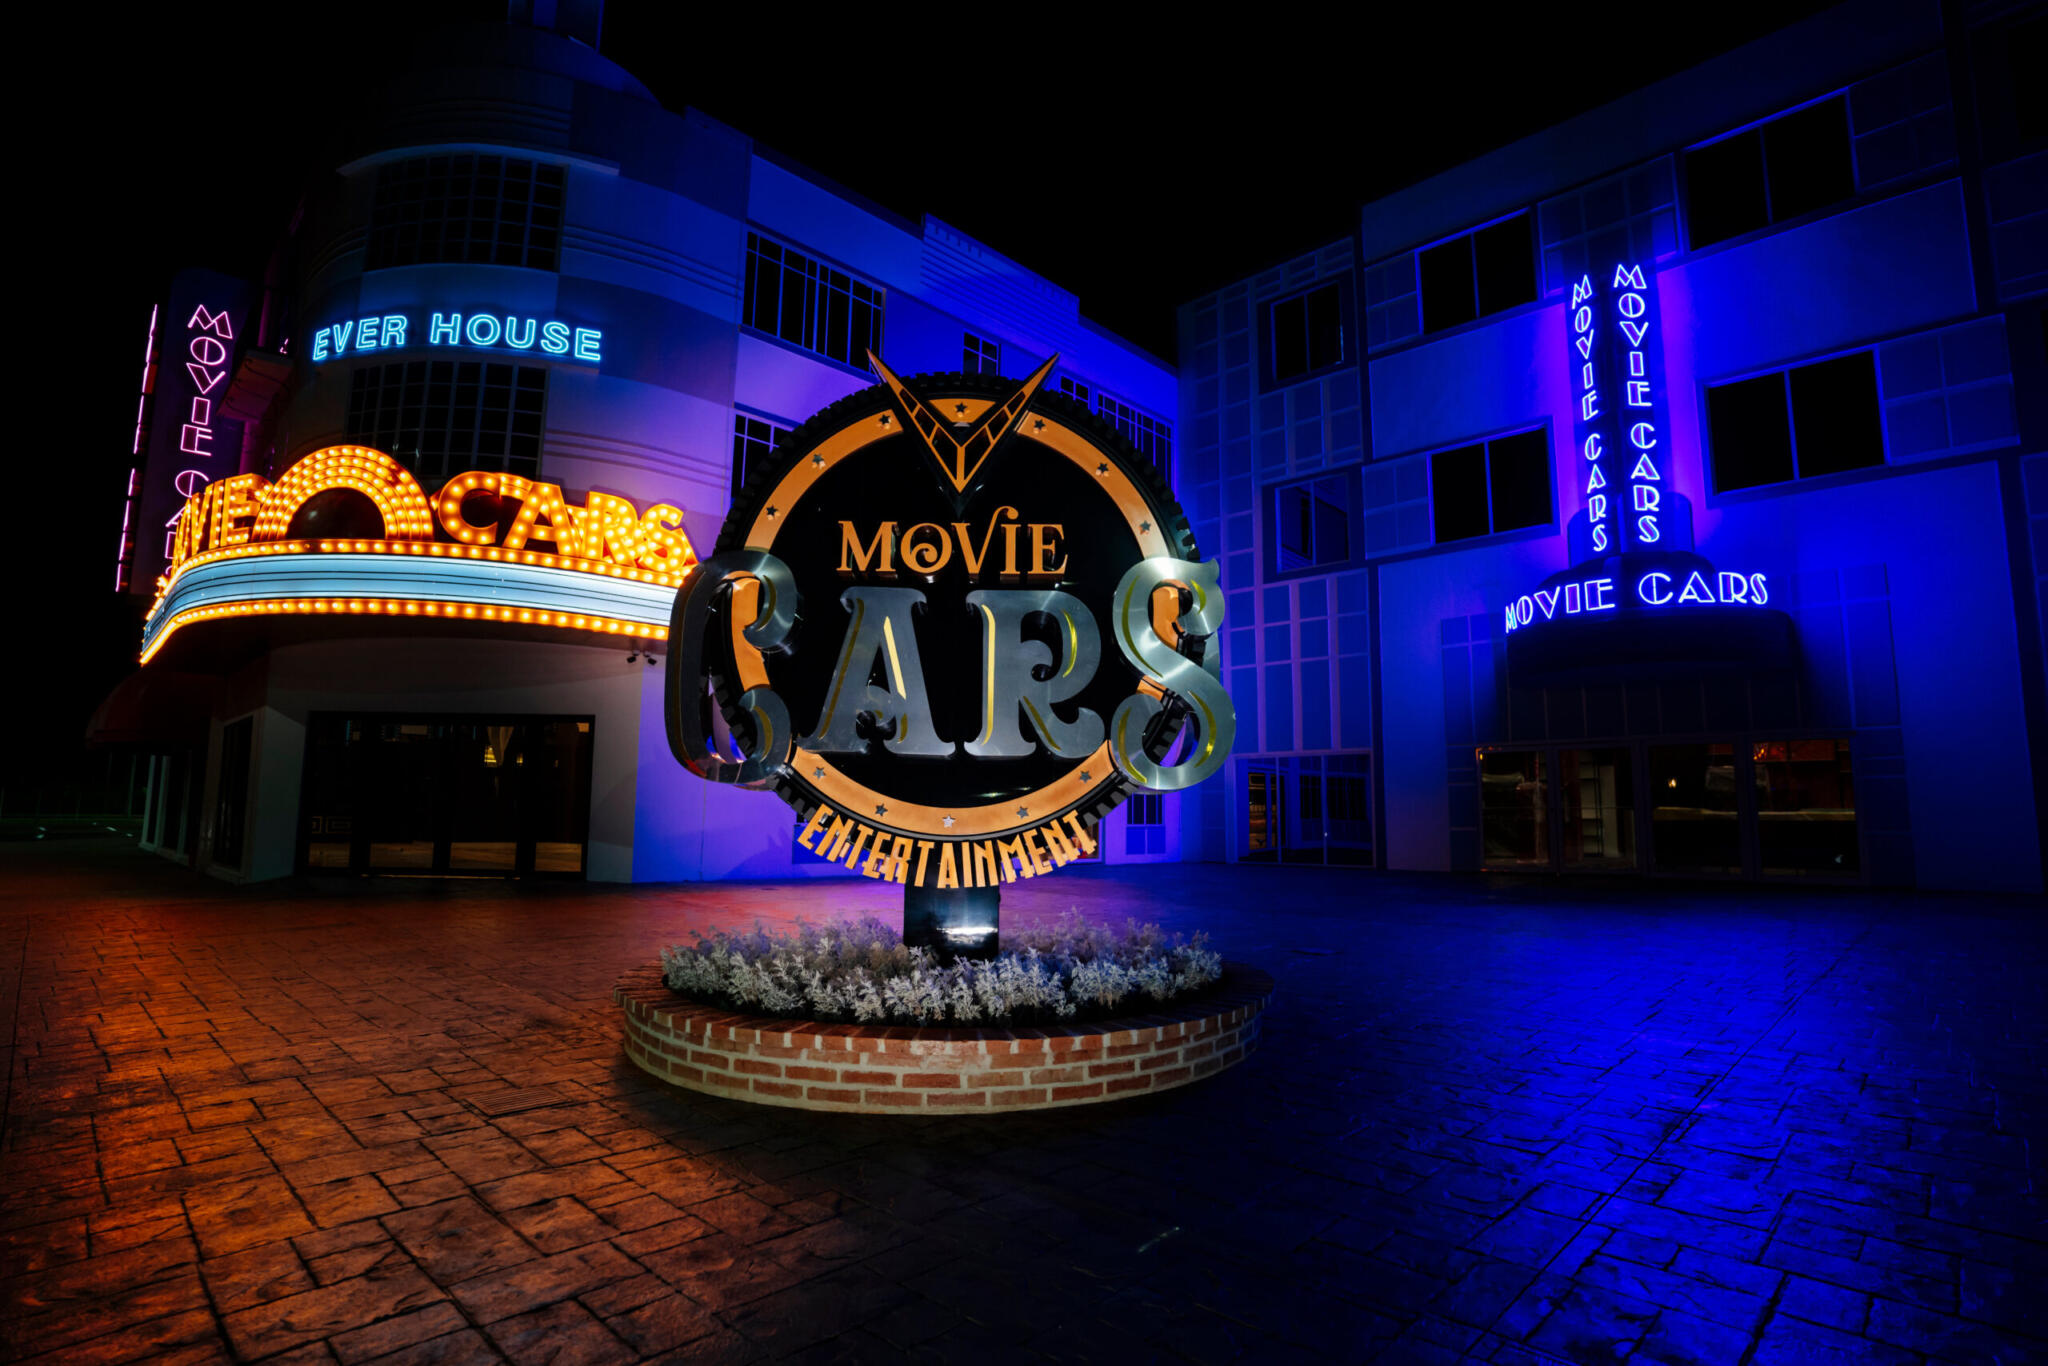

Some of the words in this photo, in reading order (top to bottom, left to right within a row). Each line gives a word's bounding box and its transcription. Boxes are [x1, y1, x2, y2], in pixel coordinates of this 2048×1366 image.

[181, 304, 234, 457] MOVIE
[312, 314, 409, 362] EVER
[428, 312, 603, 363] HOUSE
[1571, 274, 1600, 422] MOVIE
[1613, 263, 1654, 407] MOVIE
[438, 470, 692, 574] CARS
[836, 505, 1069, 576] MOVIE
[1584, 432, 1608, 552] CARS
[1630, 422, 1662, 543] CARS
[1504, 577, 1617, 635] MOVIE
[1637, 570, 1770, 605] CARS
[664, 549, 1237, 792] CARS
[797, 803, 1098, 889] ENTERTAINMENT
